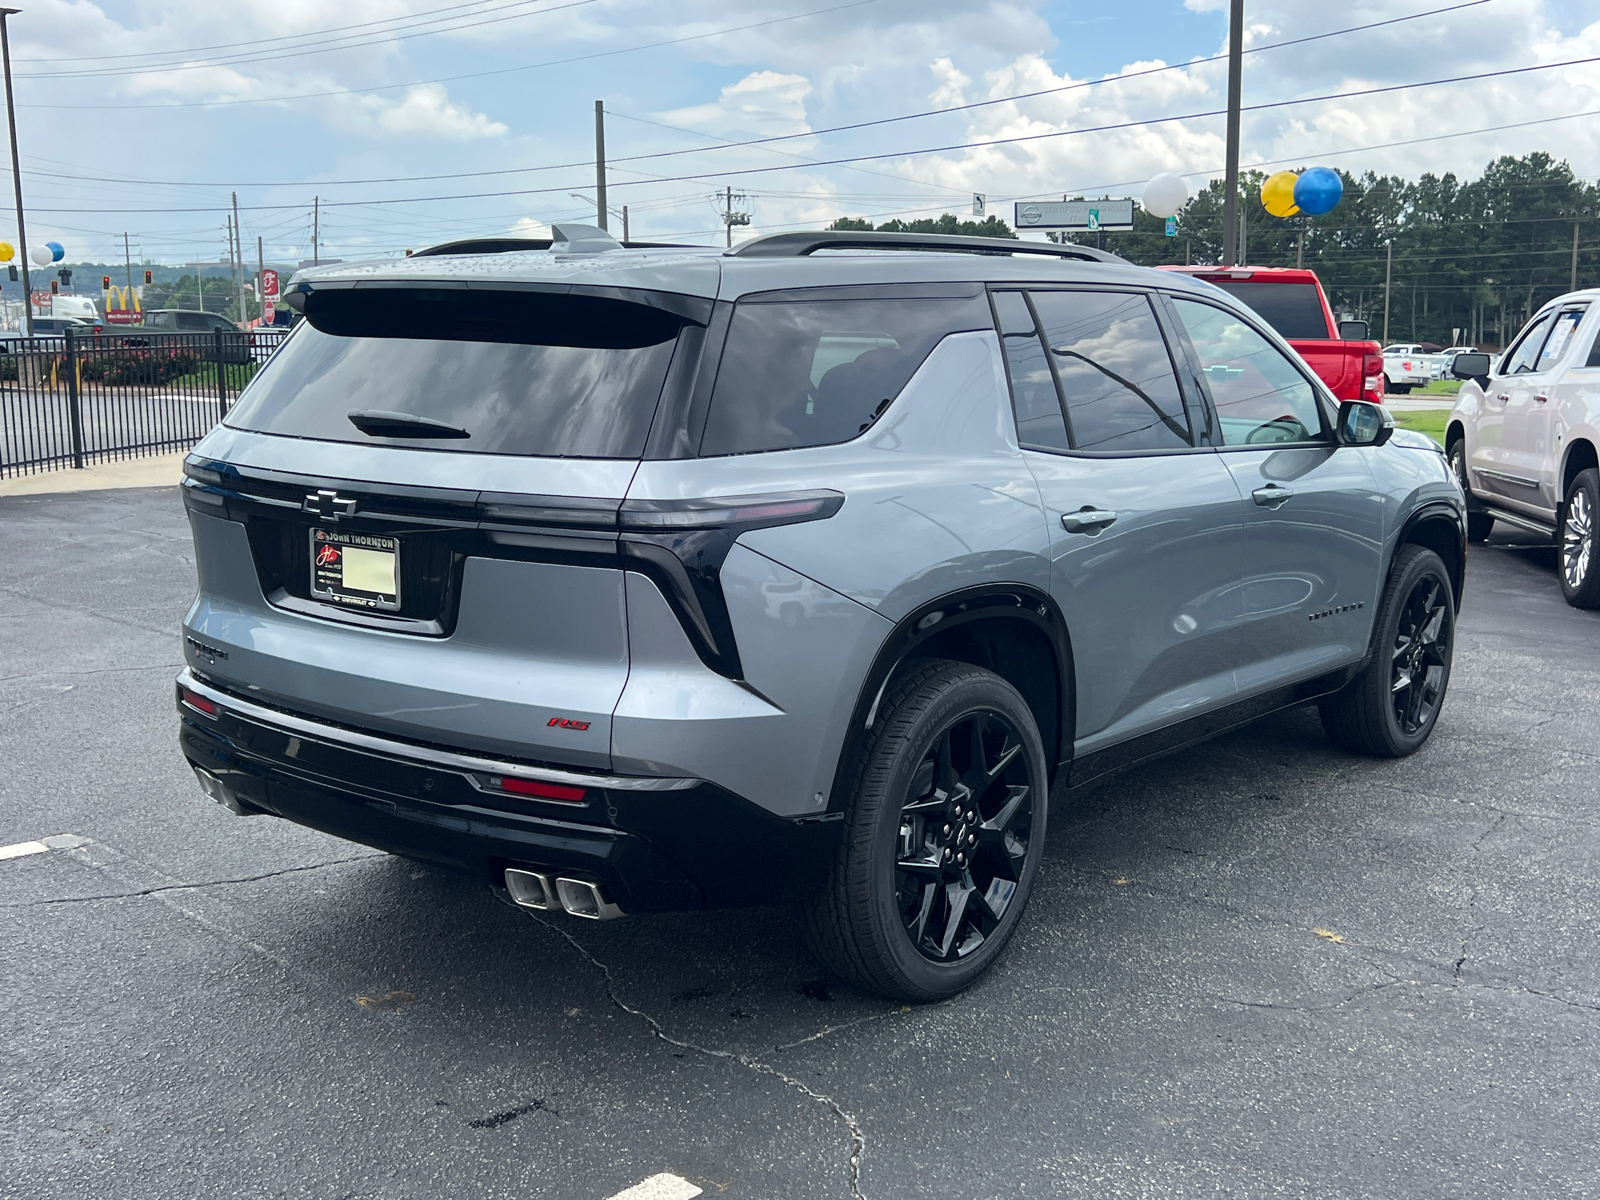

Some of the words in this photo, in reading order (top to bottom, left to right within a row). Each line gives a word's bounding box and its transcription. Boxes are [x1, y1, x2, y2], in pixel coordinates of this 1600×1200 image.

[1043, 206, 1082, 214] CERTIFIED
[1068, 214, 1104, 222] VEHICS
[1091, 218, 1096, 227] 6
[328, 532, 350, 543] JOHN
[350, 535, 394, 549] THORNTON
[341, 597, 367, 605] CHEVROLET
[546, 717, 592, 731] RS
